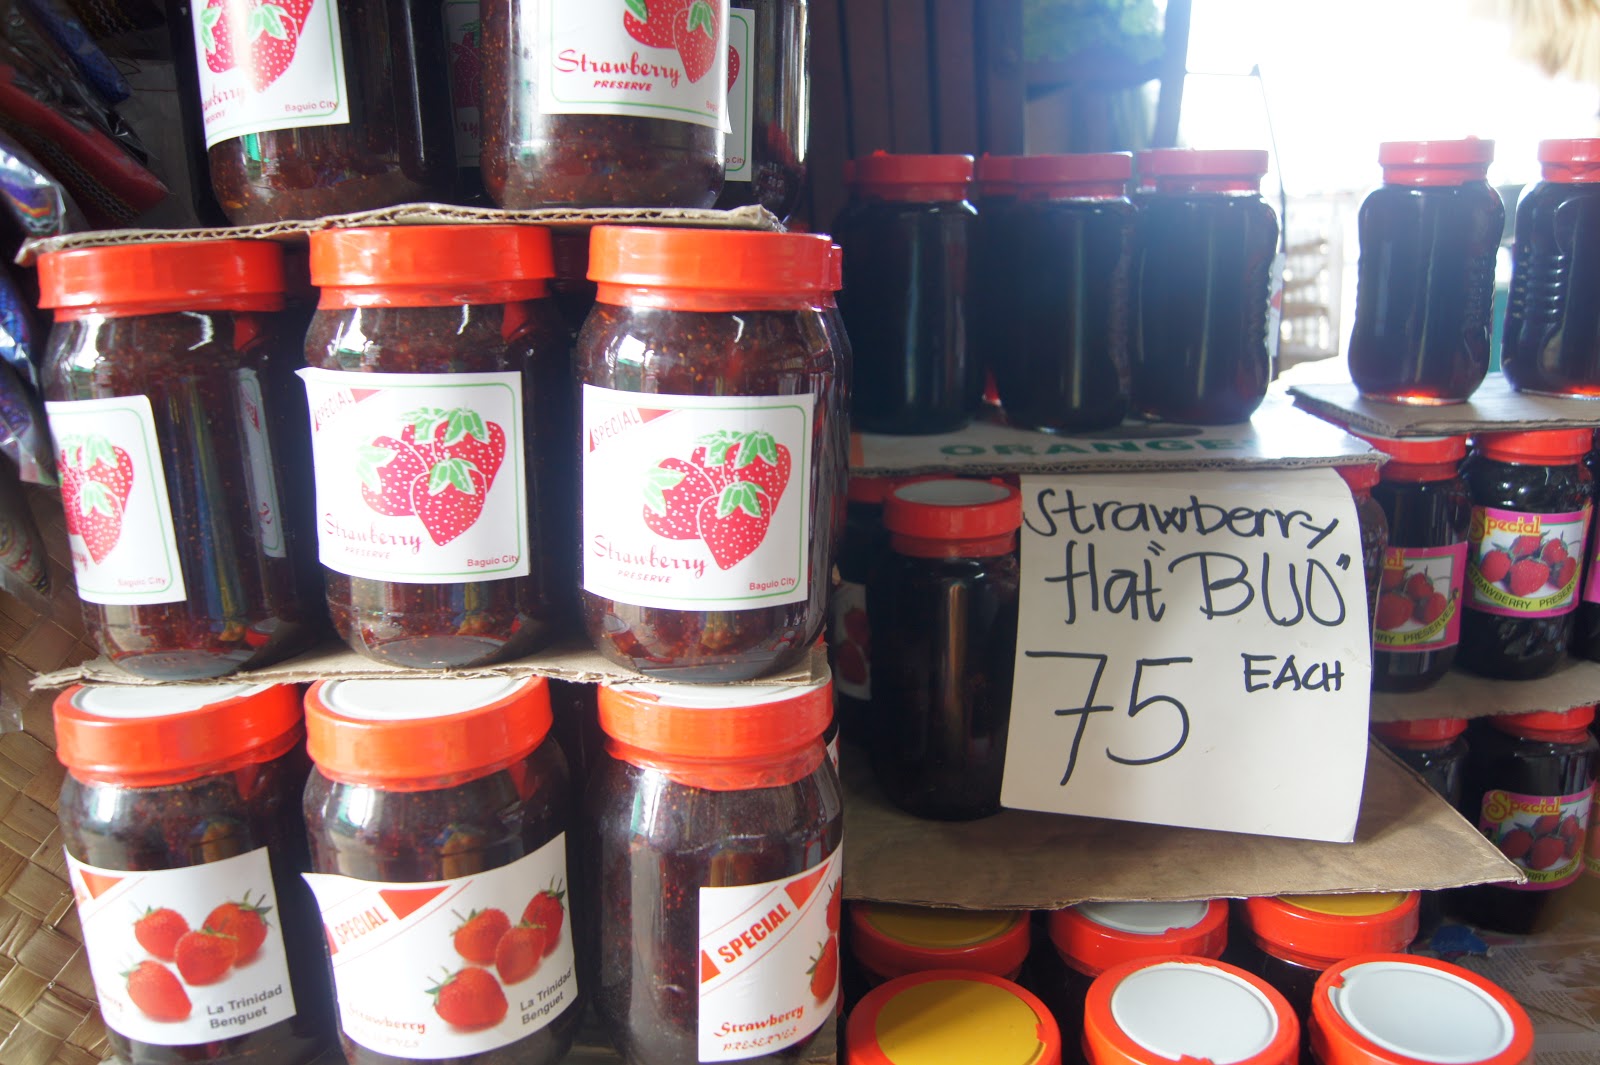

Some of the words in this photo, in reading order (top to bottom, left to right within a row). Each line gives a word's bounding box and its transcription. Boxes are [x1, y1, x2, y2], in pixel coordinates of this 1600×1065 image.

[553, 48, 682, 88] Strawberry
[593, 79, 653, 92] PRESERVE
[284, 102, 317, 113] Baguio
[319, 100, 338, 111] City
[731, 156, 745, 165] City
[316, 388, 353, 426] SPECIAL
[593, 408, 640, 446] SPECIAL
[325, 513, 423, 555] Strawberry
[1023, 488, 1339, 549] Strawberry
[1471, 508, 1541, 542] Special
[345, 546, 390, 560] PRESERVE
[467, 555, 500, 568] Baguio
[502, 553, 519, 565] City
[592, 535, 708, 578] Strawberry
[617, 569, 672, 584] PRESERVE
[749, 580, 779, 591] Baguio
[780, 577, 796, 587] City
[1403, 604, 1455, 643] PRESERVES
[1025, 650, 1193, 787] 75
[1241, 652, 1345, 692] EACH
[1484, 789, 1561, 822] Special
[334, 906, 389, 945] SPECIAL
[717, 902, 791, 964] SPECIAL
[207, 1003, 225, 1016] La
[228, 984, 283, 1011] Trinidad
[520, 998, 535, 1012] La
[536, 967, 572, 1003] Trinidad
[210, 1005, 269, 1030] Benguet
[521, 991, 565, 1025] Benguet
[714, 1005, 804, 1038] Strawberry
[723, 1026, 798, 1052] PRESERVES
